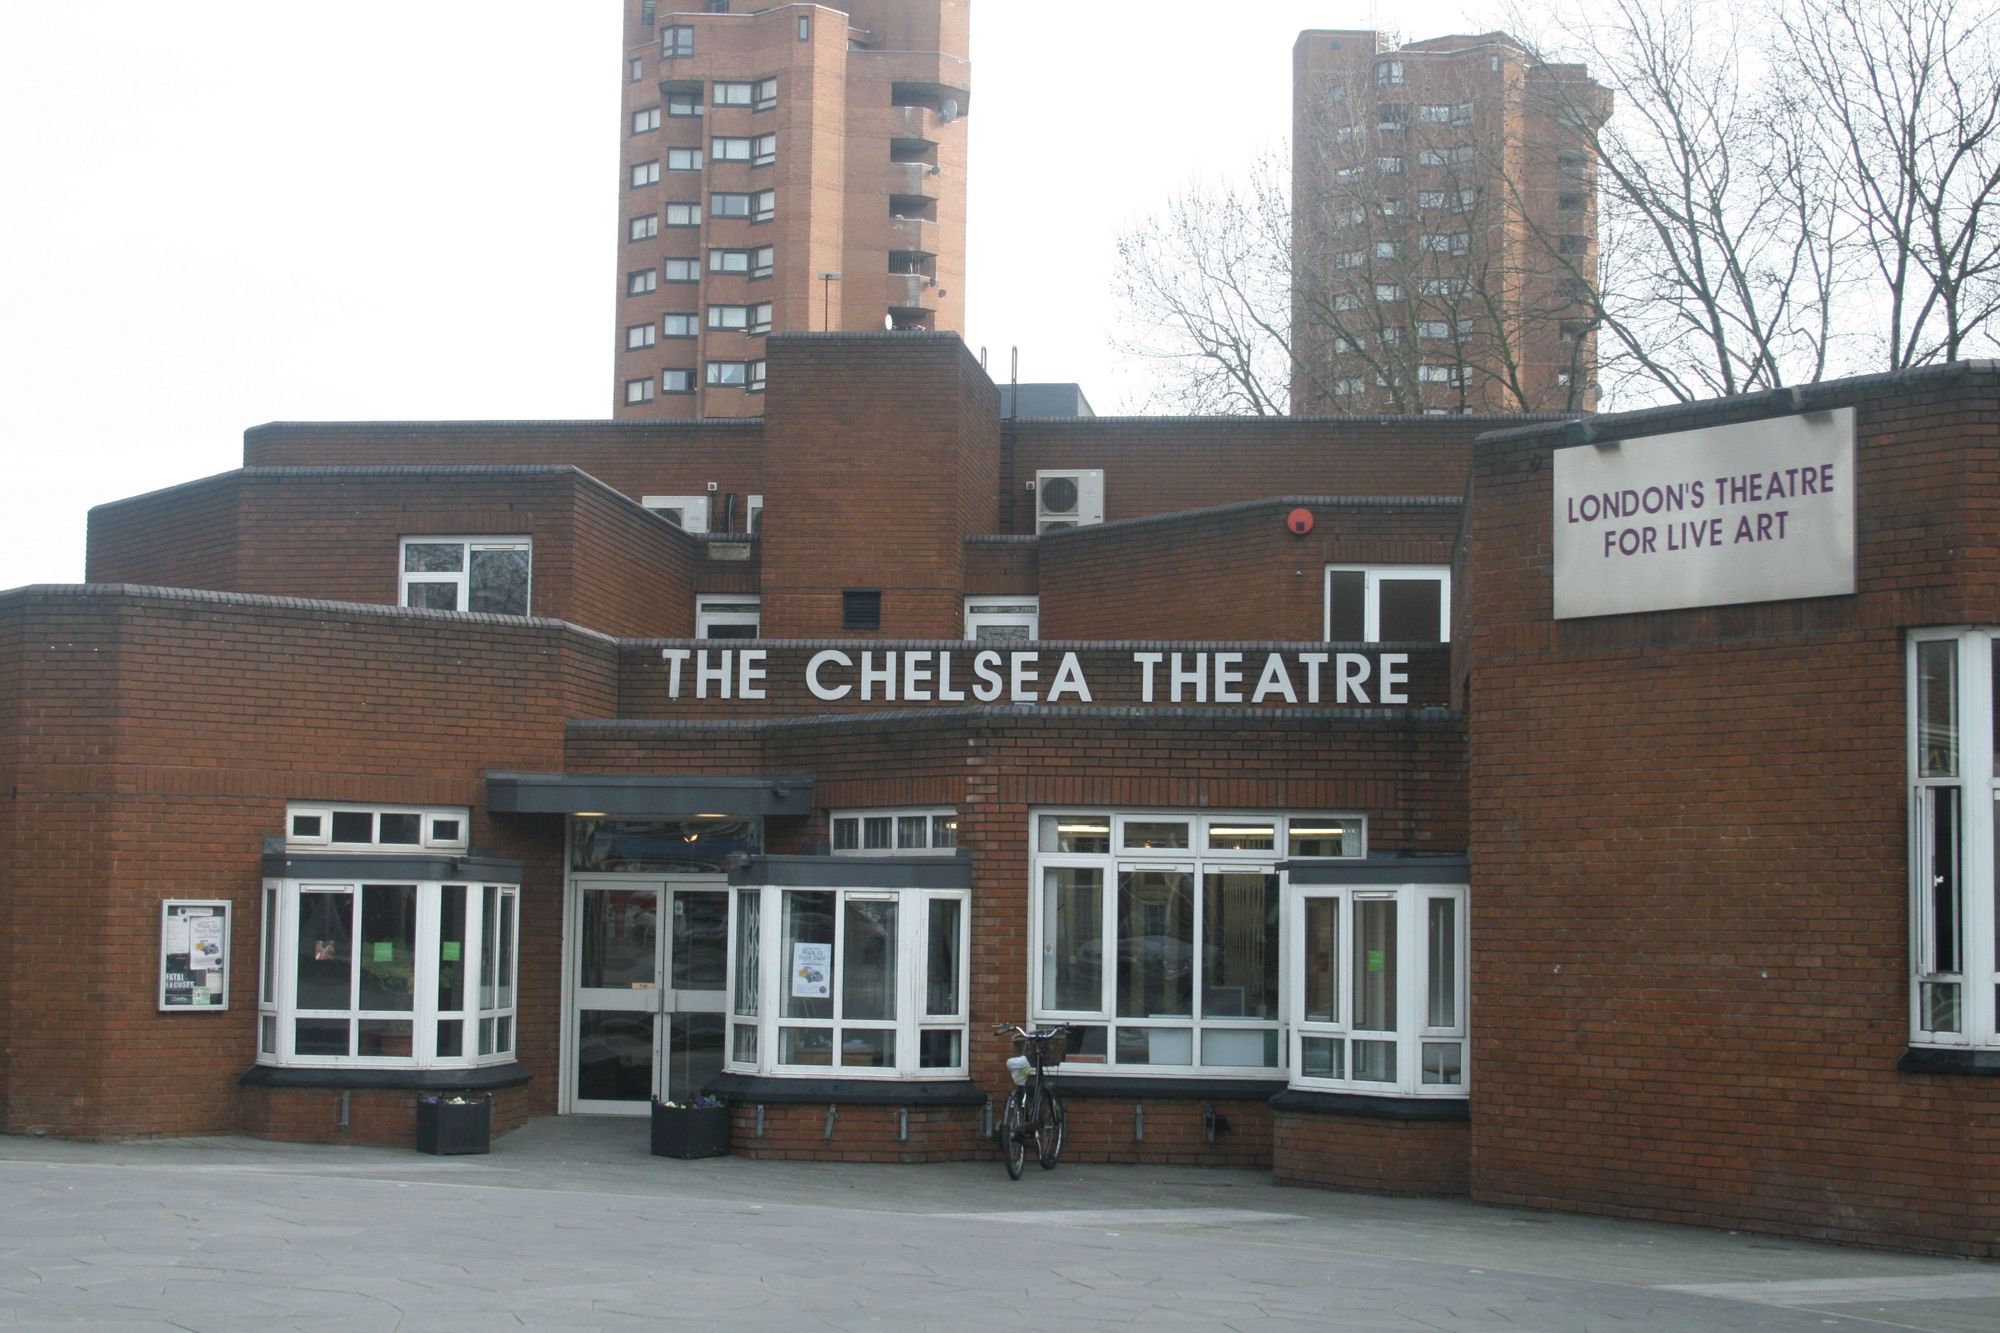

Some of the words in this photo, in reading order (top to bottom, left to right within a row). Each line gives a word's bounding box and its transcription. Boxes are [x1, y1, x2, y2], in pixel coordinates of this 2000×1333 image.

[1567, 480, 1704, 523] LONDON'S
[1715, 464, 1834, 505] THEATRE
[1604, 526, 1657, 557] FOR
[1667, 518, 1722, 551] LIVE
[1734, 511, 1789, 544] ART
[661, 648, 767, 699] THE
[804, 649, 1092, 702] CHELSEA
[1134, 652, 1408, 704] THEATRE
